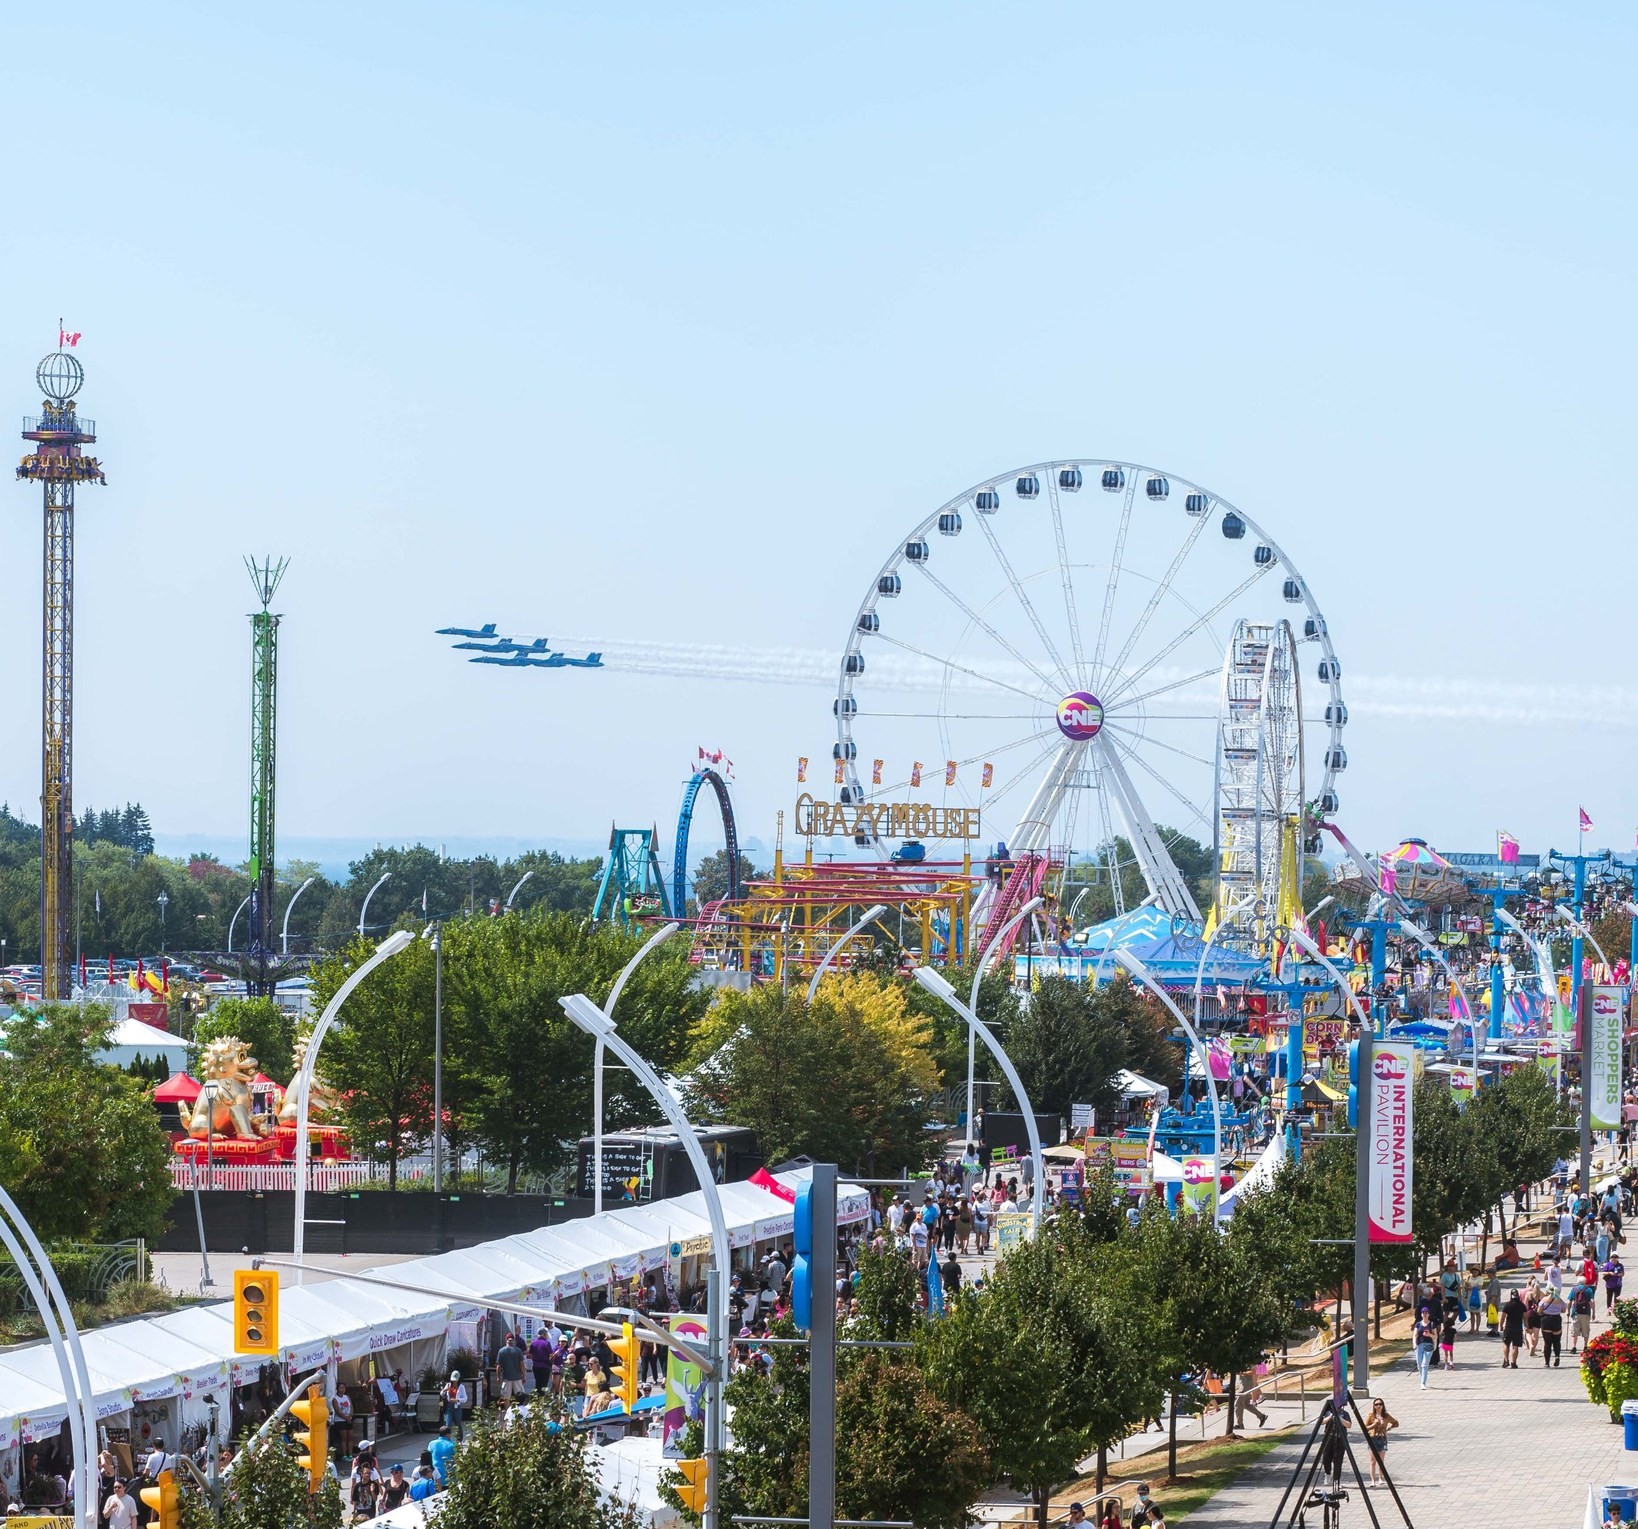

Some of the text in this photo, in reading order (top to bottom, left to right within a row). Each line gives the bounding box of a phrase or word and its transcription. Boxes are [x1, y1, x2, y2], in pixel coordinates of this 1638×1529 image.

[1059, 709, 1101, 726] CNE
[796, 793, 980, 839] CRAZY MOUSE
[1306, 1022, 1342, 1033] CORN
[1306, 1034, 1341, 1044] DOS
[1593, 1017, 1605, 1079] MARKET
[1372, 1059, 1408, 1074] CNE
[1606, 1018, 1619, 1105] SHOPPERS
[1376, 1085, 1389, 1165] PAVILION
[1392, 1085, 1406, 1229] INTERNATIONAL
[1183, 1165, 1215, 1179] CNE
[369, 1327, 421, 1349] Quick Draw Caricatures
